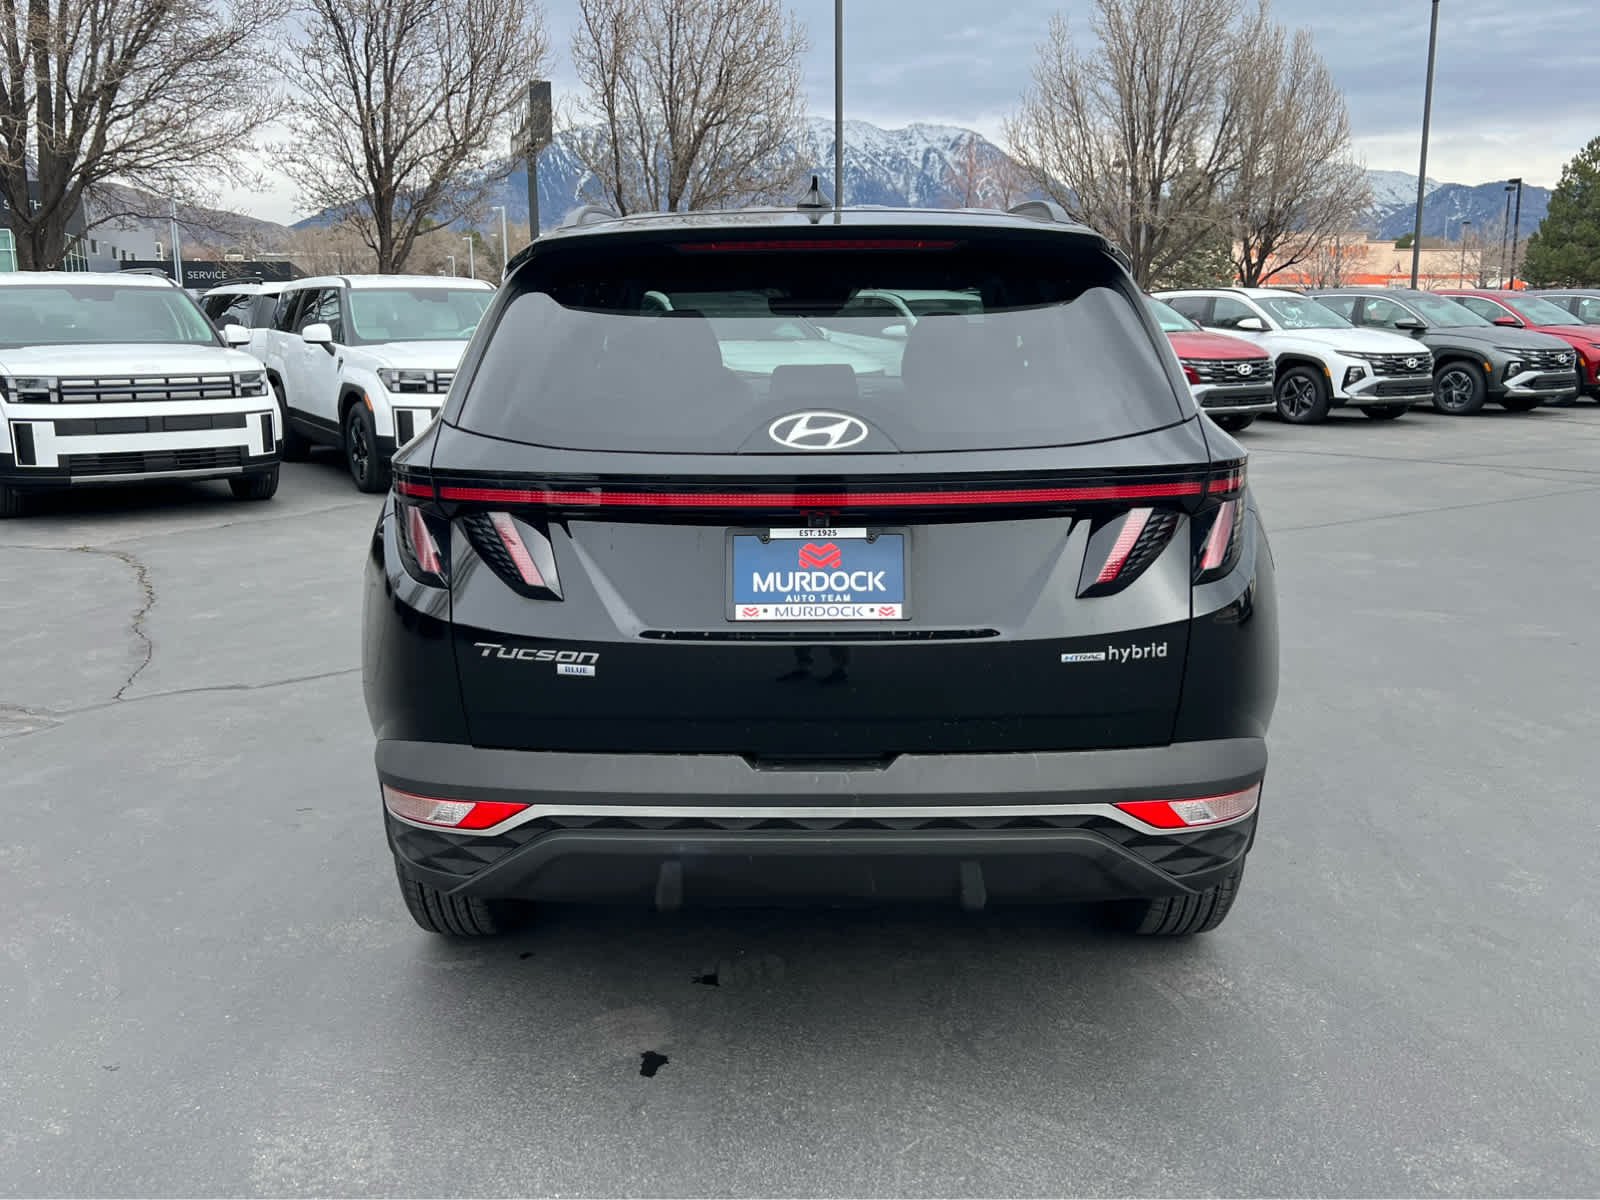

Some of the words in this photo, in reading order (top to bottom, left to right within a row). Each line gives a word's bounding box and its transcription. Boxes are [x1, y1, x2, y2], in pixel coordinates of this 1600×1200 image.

[187, 270, 228, 279] SERVICE
[817, 529, 837, 537] 1925
[752, 571, 886, 593] MURDOCK
[785, 594, 816, 602] AUTO
[820, 594, 851, 602] TEAM
[774, 606, 864, 617] MURDOCK
[1108, 642, 1168, 663] hybrid
[564, 666, 588, 674] BLUE
